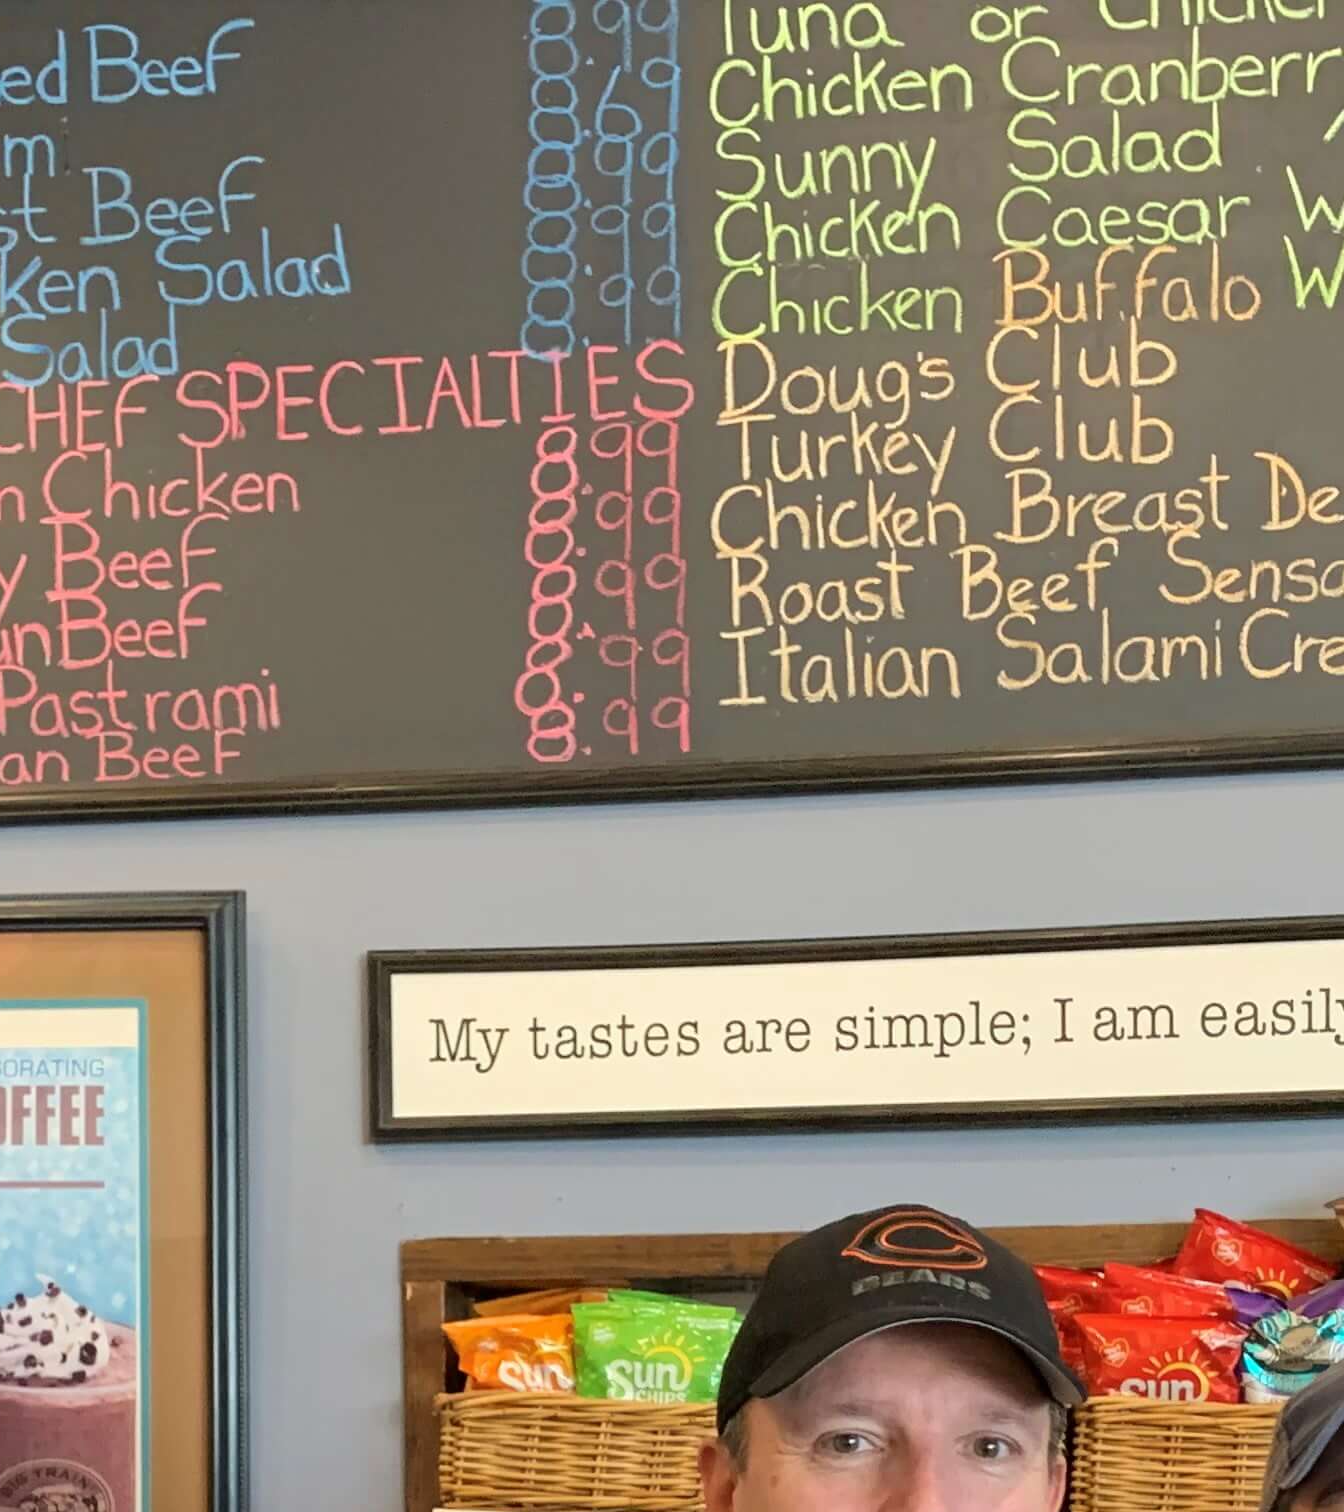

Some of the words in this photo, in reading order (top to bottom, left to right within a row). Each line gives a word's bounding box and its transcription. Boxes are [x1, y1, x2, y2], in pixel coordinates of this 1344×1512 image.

[83, 19, 255, 102] Beef
[971, 5, 1048, 42] or
[710, 52, 975, 128] Chicken
[82, 156, 265, 247] Beef
[716, 128, 936, 215] Sunny
[1006, 105, 1222, 180] Salad
[155, 223, 353, 308] Salad
[714, 196, 961, 270] Chicken
[996, 186, 1252, 250] Caesar
[712, 258, 963, 343] Chicken
[995, 243, 1261, 329] Buffalo
[1, 303, 182, 391] Salad
[985, 326, 1179, 397] Club
[176, 341, 696, 450] SPECIALTIES
[42, 447, 302, 522] Chicken
[716, 412, 957, 495] Turkey
[987, 396, 1175, 466] Club
[711, 479, 966, 554] Chicken
[997, 454, 1231, 541] Breast
[44, 514, 231, 598] Beef
[726, 546, 915, 626] Roast
[951, 537, 1120, 619] Beef
[46, 582, 223, 670] Beef
[719, 622, 961, 706] Italian
[997, 608, 1224, 688] Salami
[429, 1016, 510, 1073] My
[529, 1014, 700, 1062] tastes
[723, 1016, 812, 1055] are
[833, 1000, 1034, 1057] simple;
[1053, 997, 1075, 1044] I
[1093, 1004, 1180, 1041] am
[851, 1268, 992, 1300] BEARS
